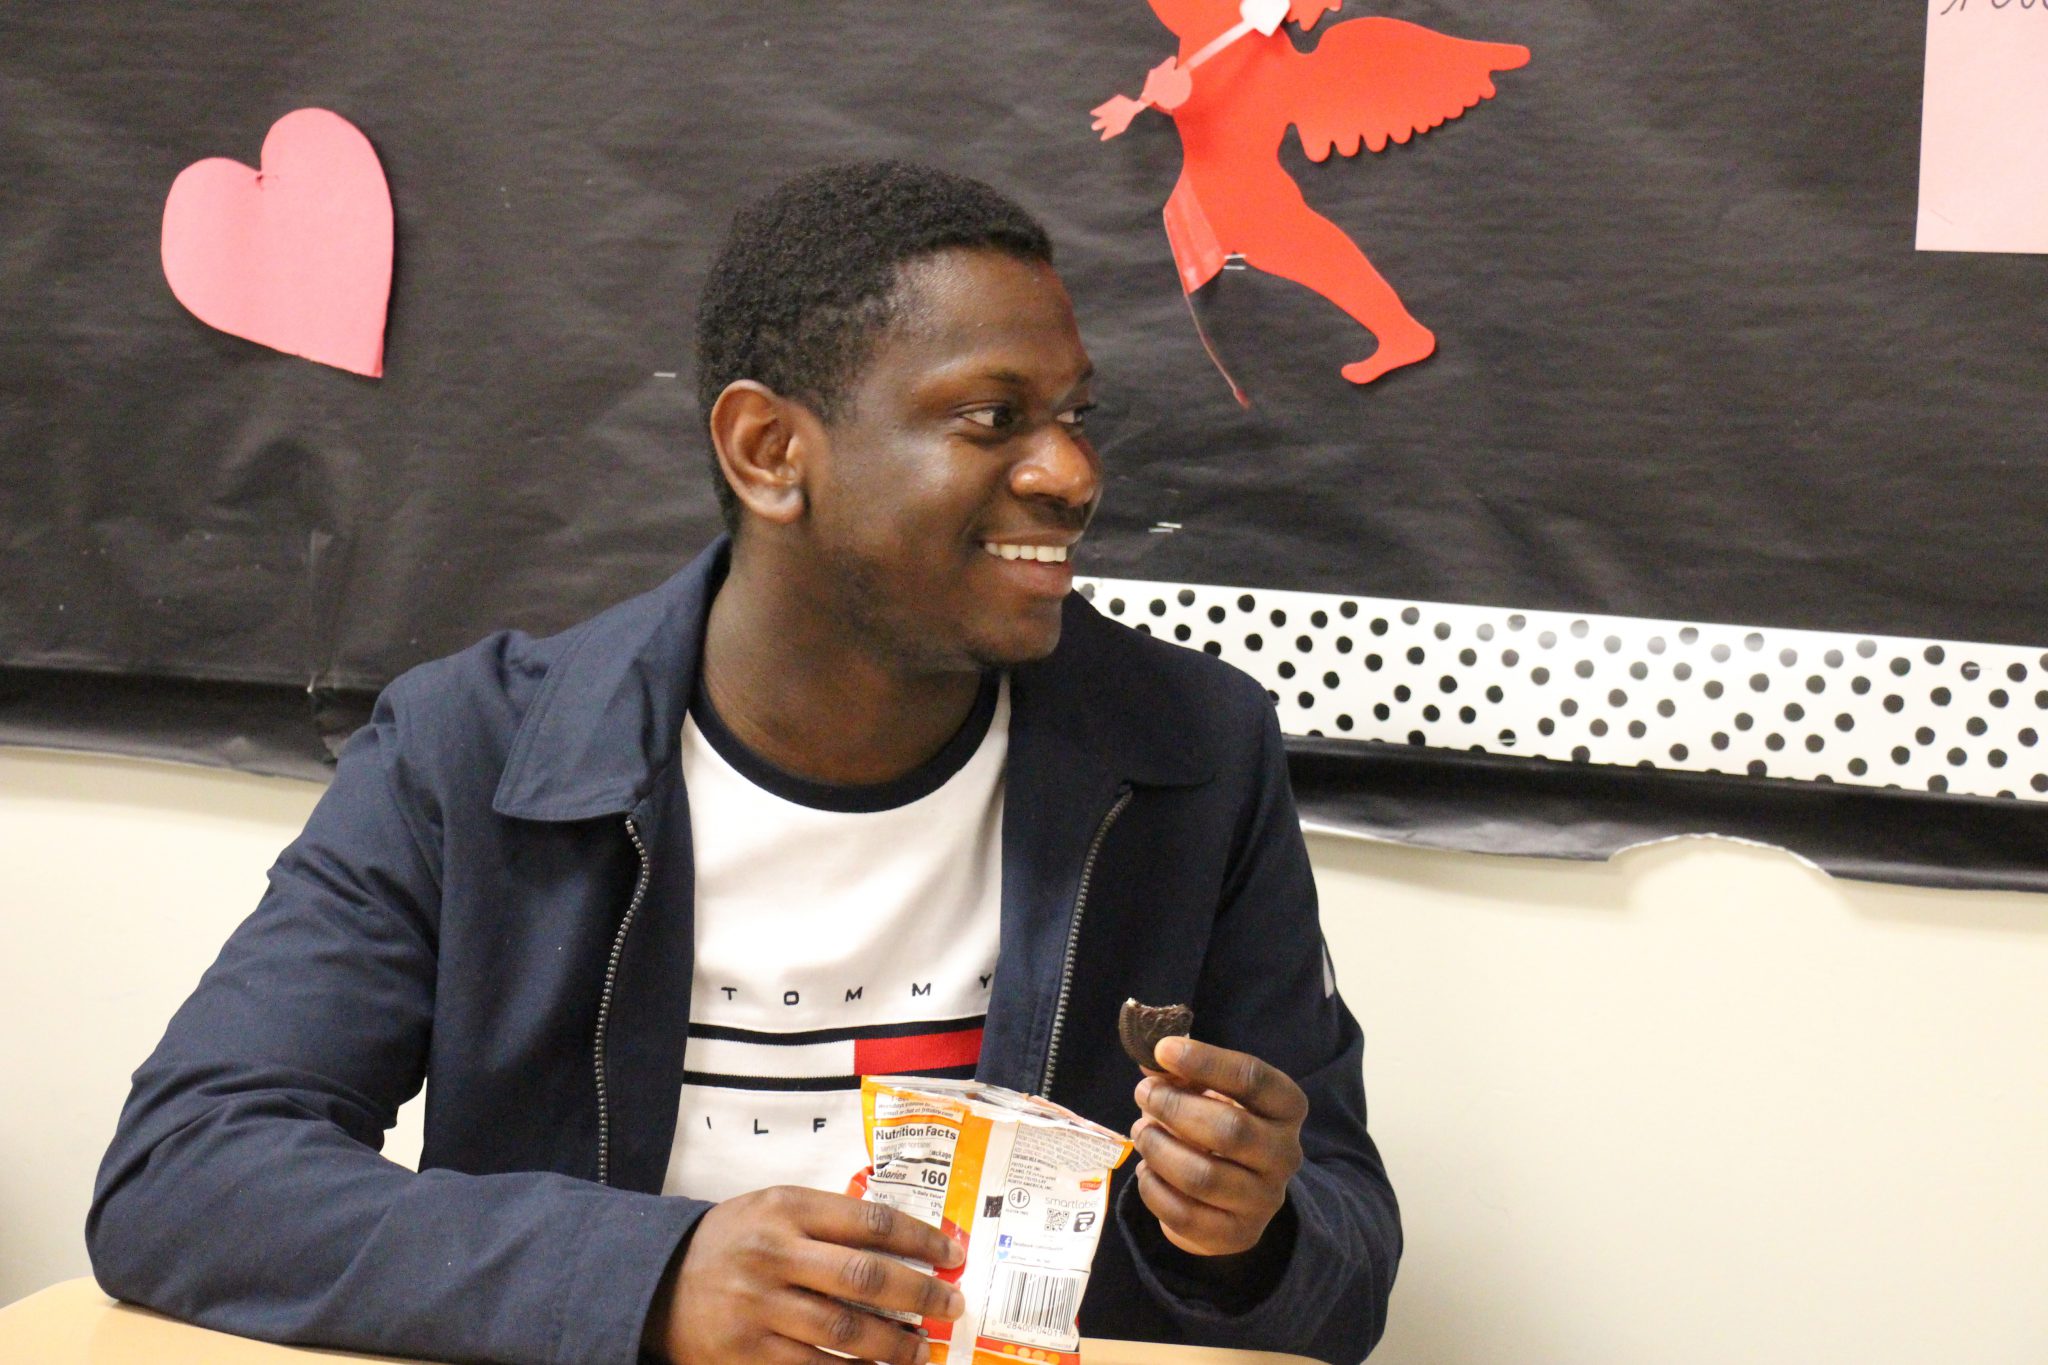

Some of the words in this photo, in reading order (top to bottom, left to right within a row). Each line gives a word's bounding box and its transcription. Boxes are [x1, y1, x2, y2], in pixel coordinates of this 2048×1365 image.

[721, 973, 992, 1006] TOMMY
[706, 1116, 827, 1135] ILF
[876, 1125, 924, 1140] Nutrition
[925, 1125, 957, 1140] Facts
[877, 1169, 907, 1180] alories
[921, 1168, 947, 1186] 160
